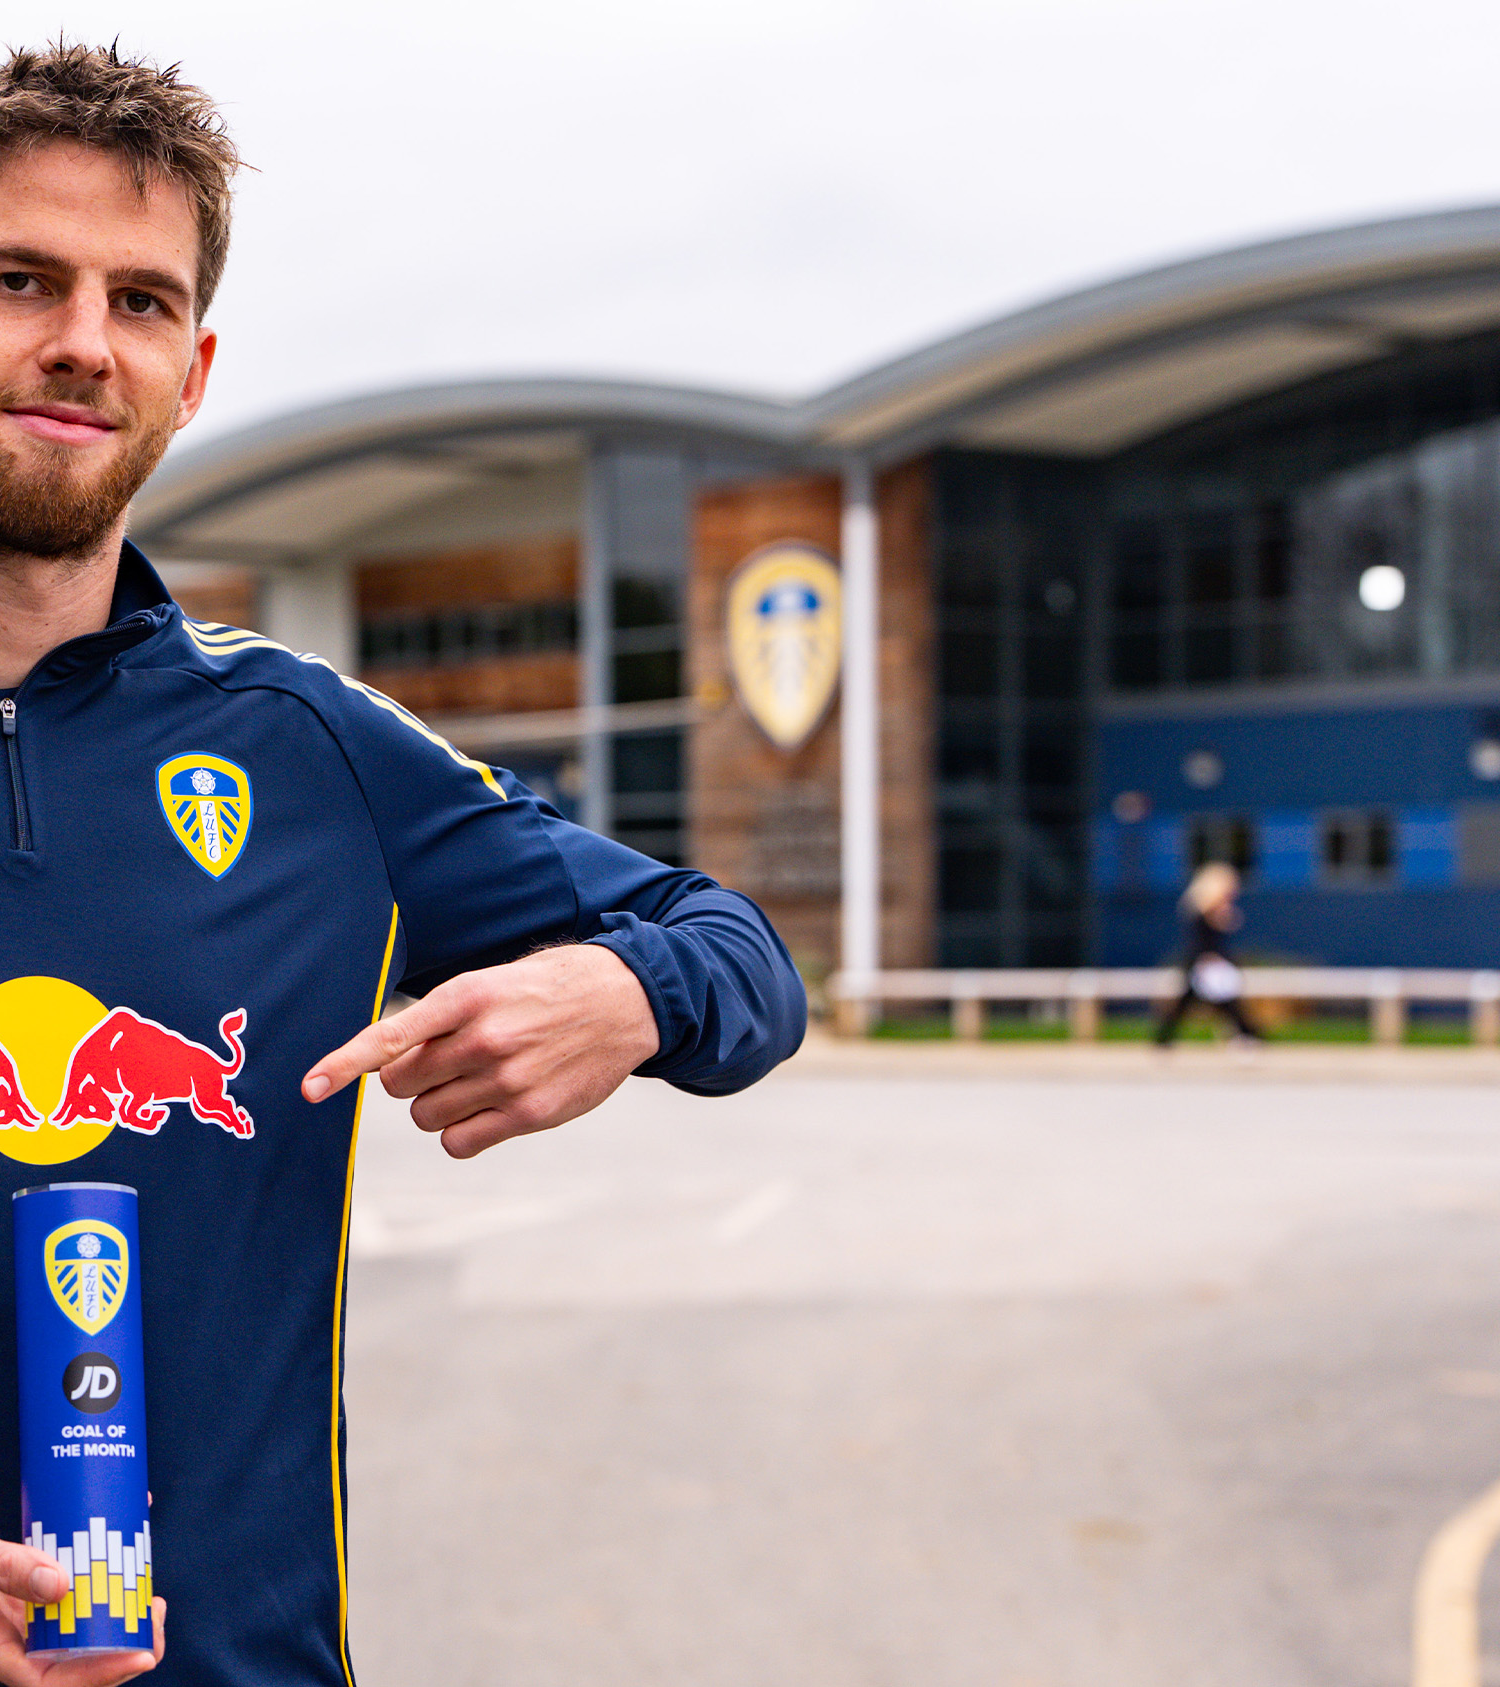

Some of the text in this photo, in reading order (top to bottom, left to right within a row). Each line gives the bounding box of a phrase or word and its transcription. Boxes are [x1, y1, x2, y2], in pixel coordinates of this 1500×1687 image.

[203, 802, 218, 859] LUFC
[83, 1264, 99, 1319] LUFC
[71, 1365, 117, 1400] JD
[61, 1424, 126, 1438] GOAL OF
[51, 1443, 135, 1458] THE MONTH
